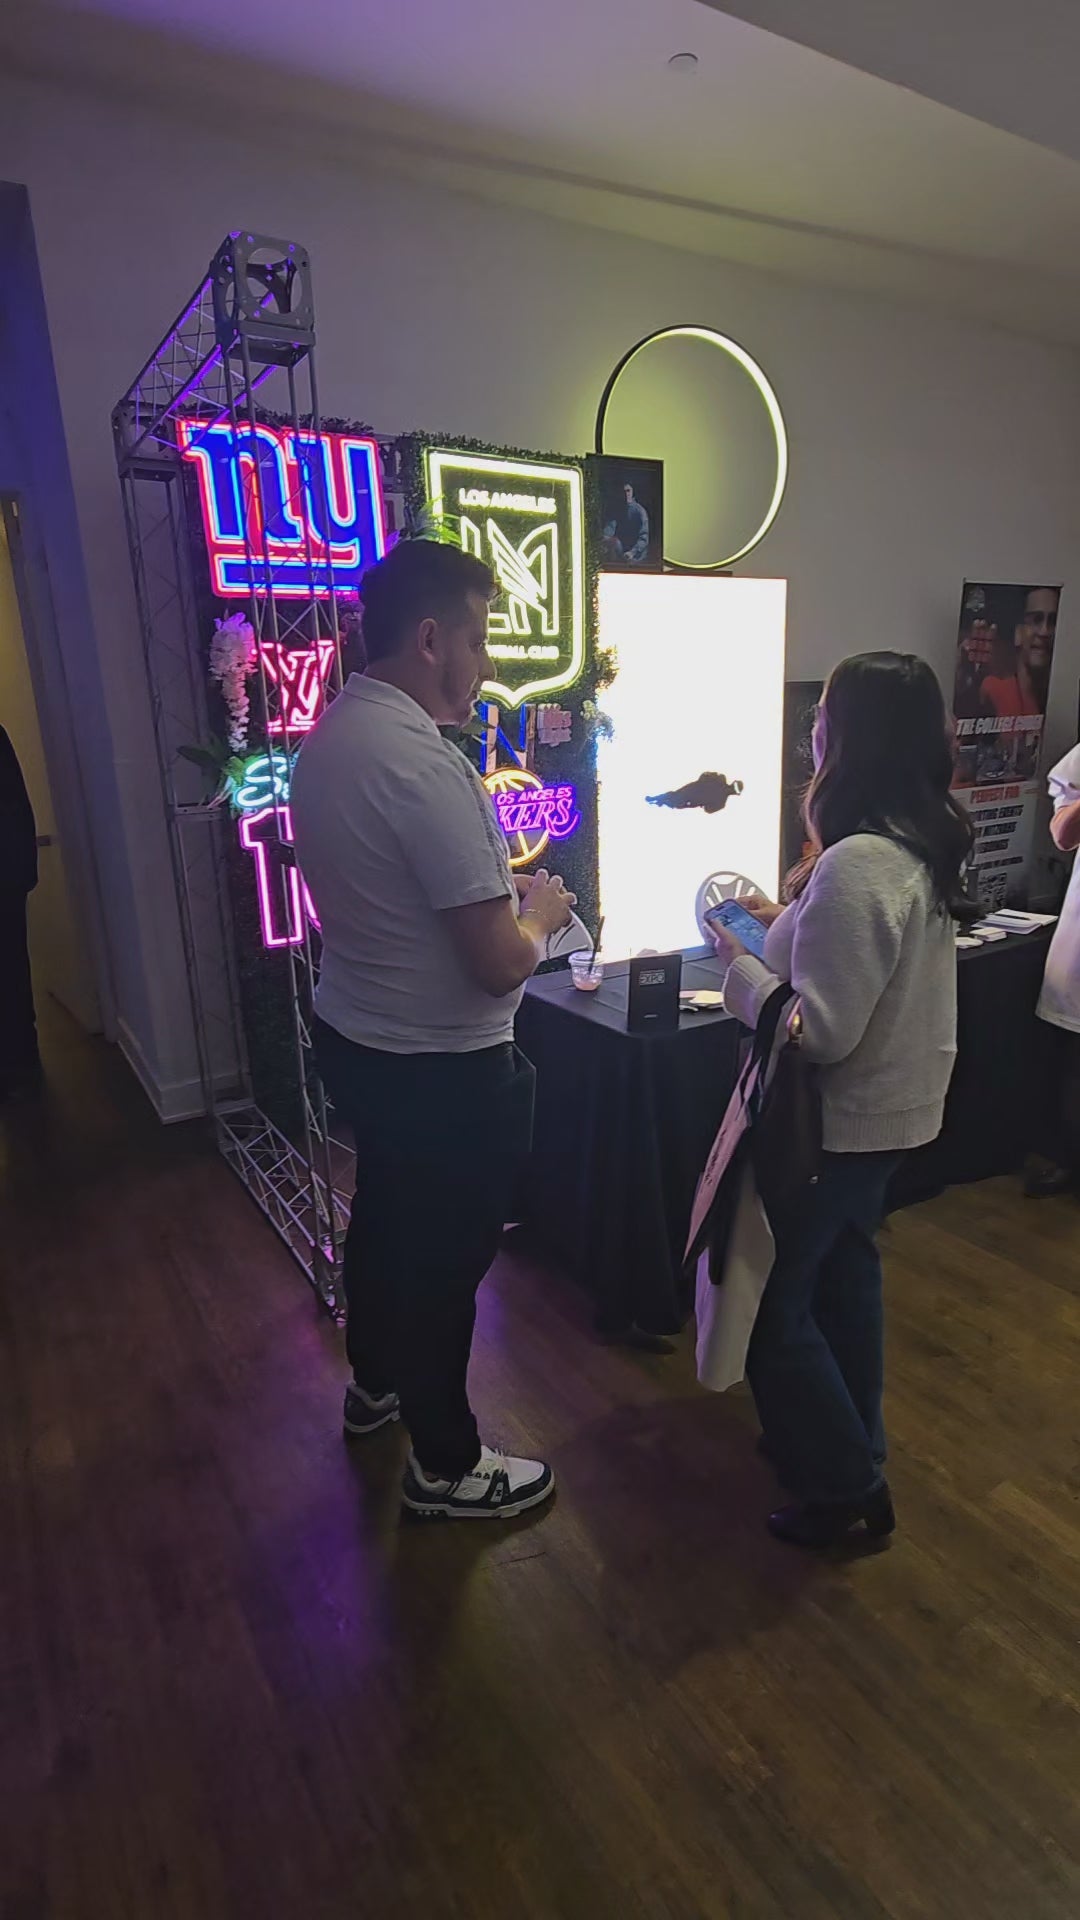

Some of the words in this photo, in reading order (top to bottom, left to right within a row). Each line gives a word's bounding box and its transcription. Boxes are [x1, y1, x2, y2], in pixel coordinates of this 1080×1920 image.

[459, 487, 490, 508] LOS
[489, 493, 557, 515] ANGELES
[956, 718, 976, 736] THE
[496, 791, 517, 806] OS
[517, 786, 573, 803] ANGELES
[498, 797, 577, 837] KERS
